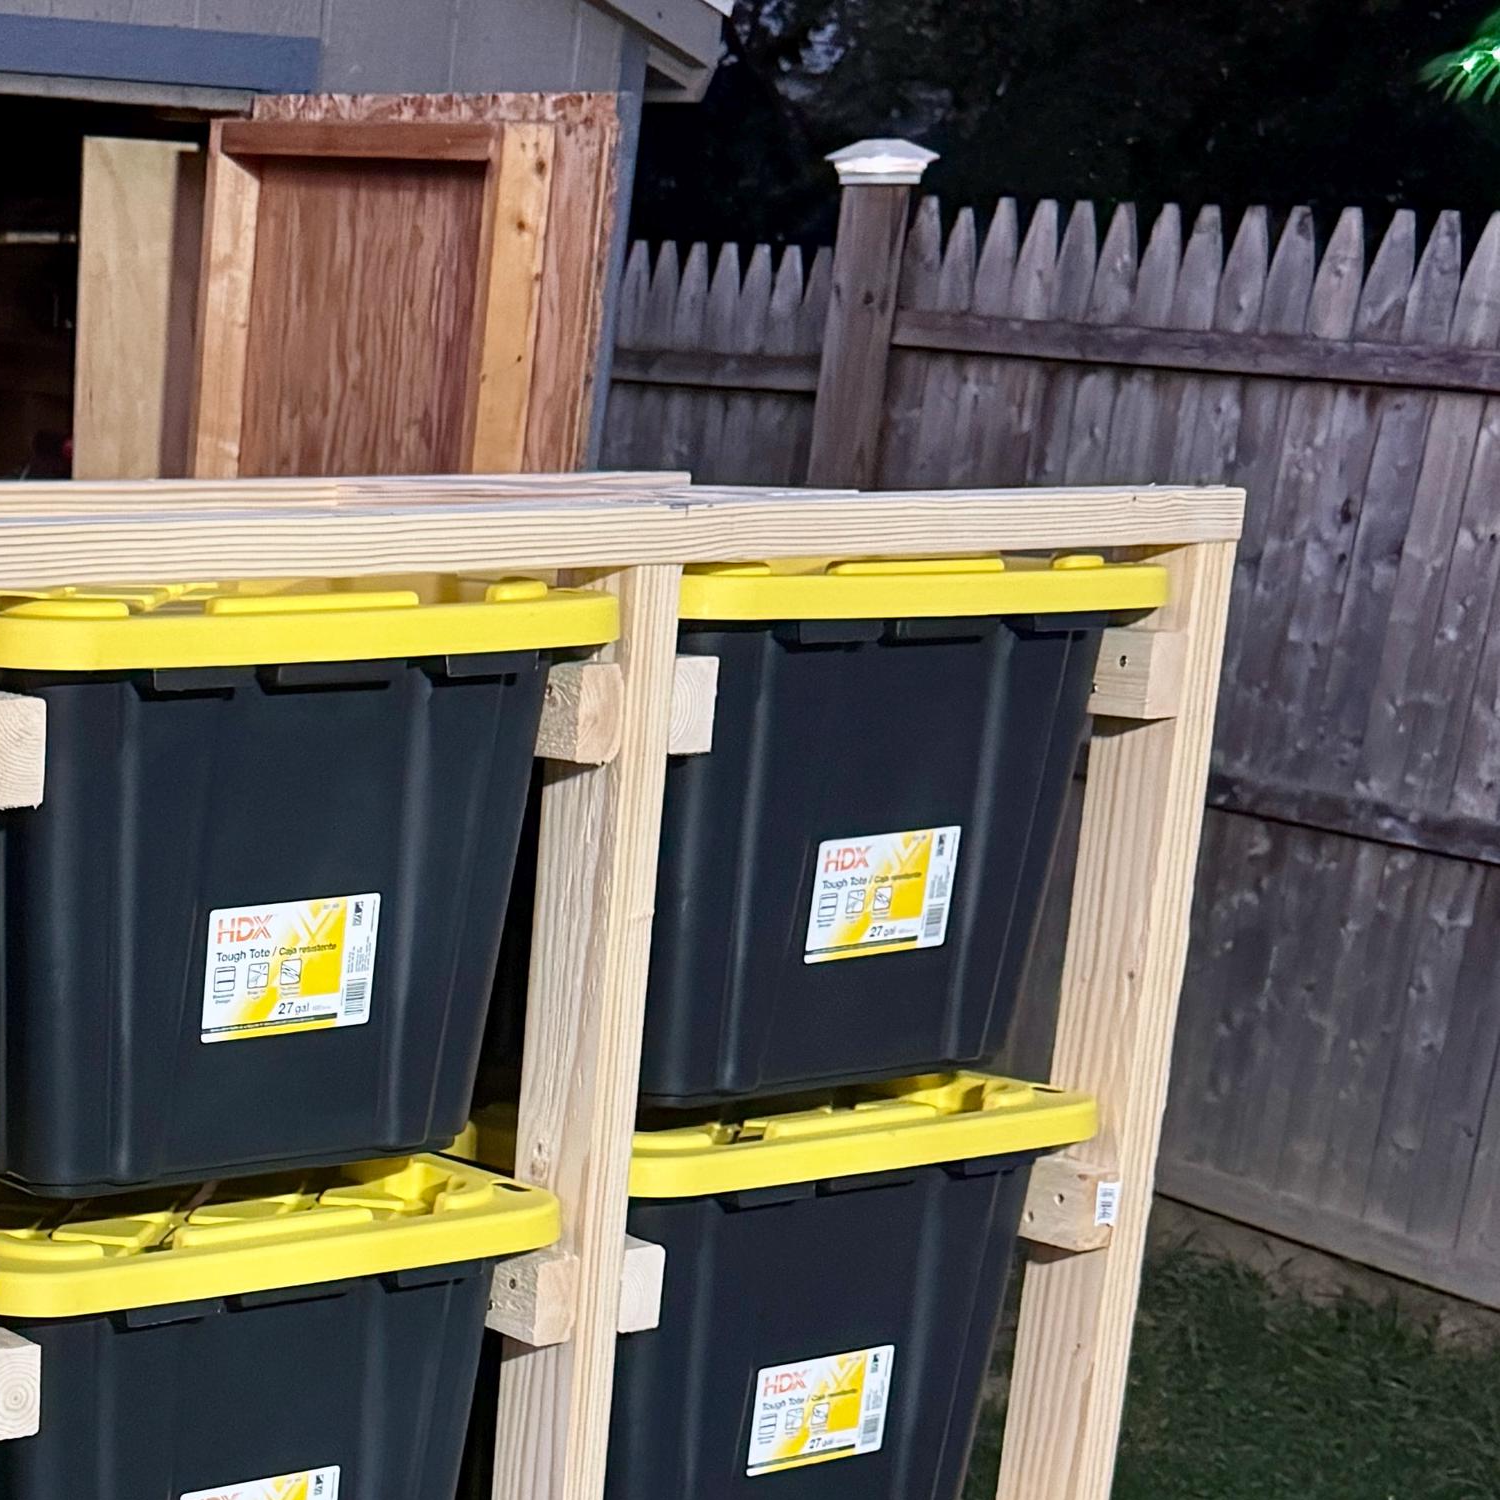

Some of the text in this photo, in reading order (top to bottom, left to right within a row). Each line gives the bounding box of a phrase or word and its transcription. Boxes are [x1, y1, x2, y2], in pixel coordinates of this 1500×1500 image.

[824, 846, 872, 873] HDX
[822, 879, 847, 889] Tough
[217, 915, 273, 944] HDX
[870, 926, 883, 937] 27
[217, 951, 246, 962] Tough
[250, 949, 270, 958] Tote
[280, 948, 296, 956] Caja
[278, 1002, 293, 1014] 27
[295, 1003, 309, 1015] gal
[763, 1370, 807, 1397] HDX
[809, 1438, 822, 1449] 27
